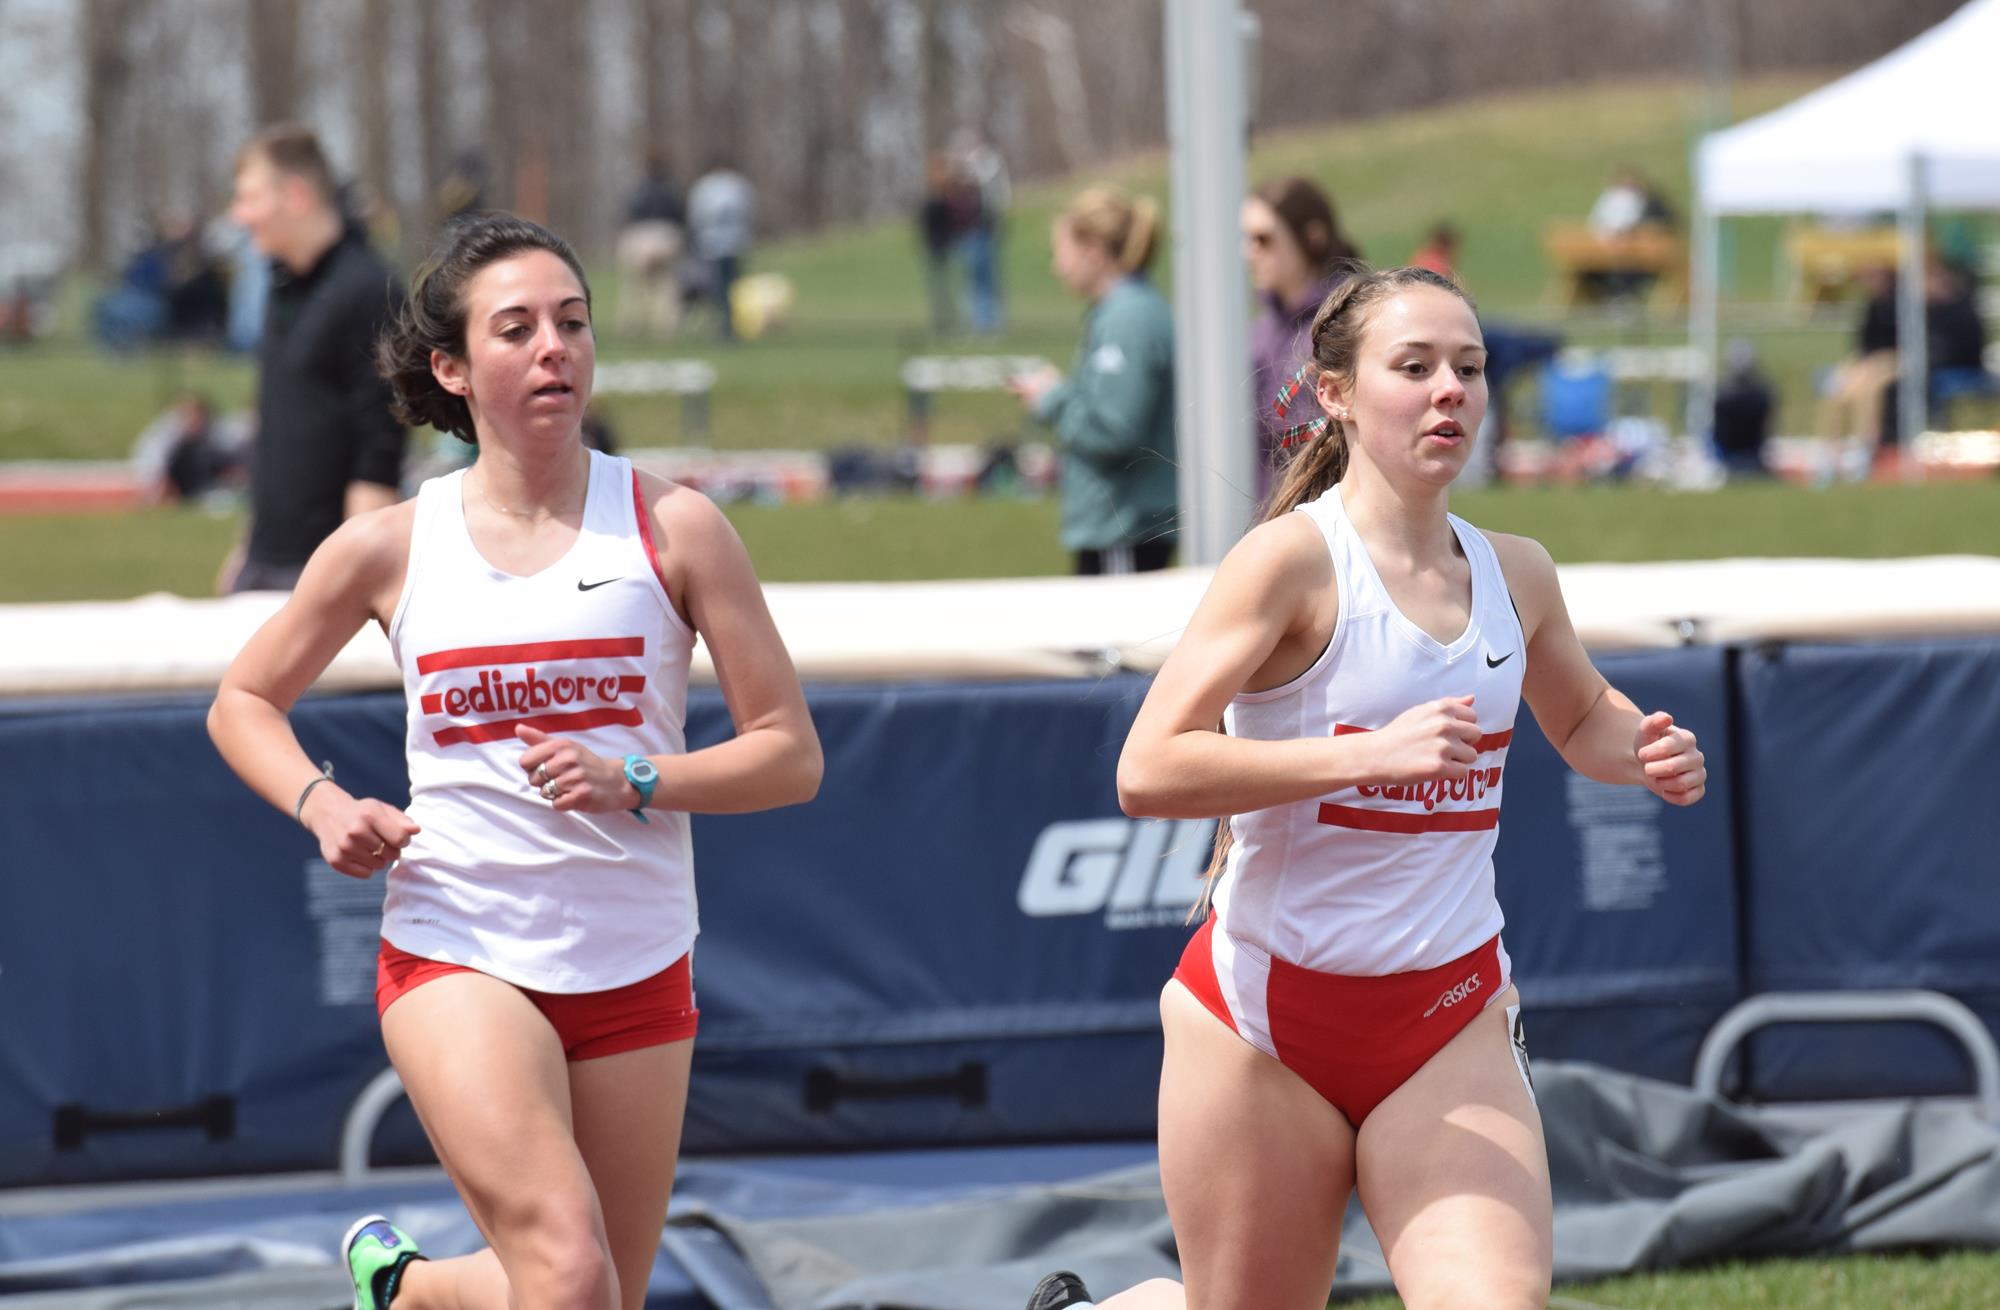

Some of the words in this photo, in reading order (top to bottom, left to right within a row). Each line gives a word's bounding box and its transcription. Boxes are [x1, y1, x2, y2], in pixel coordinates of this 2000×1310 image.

[444, 667, 621, 717] edinboro
[1017, 817, 1218, 917] GIL
[1442, 972, 1481, 1008] asics
